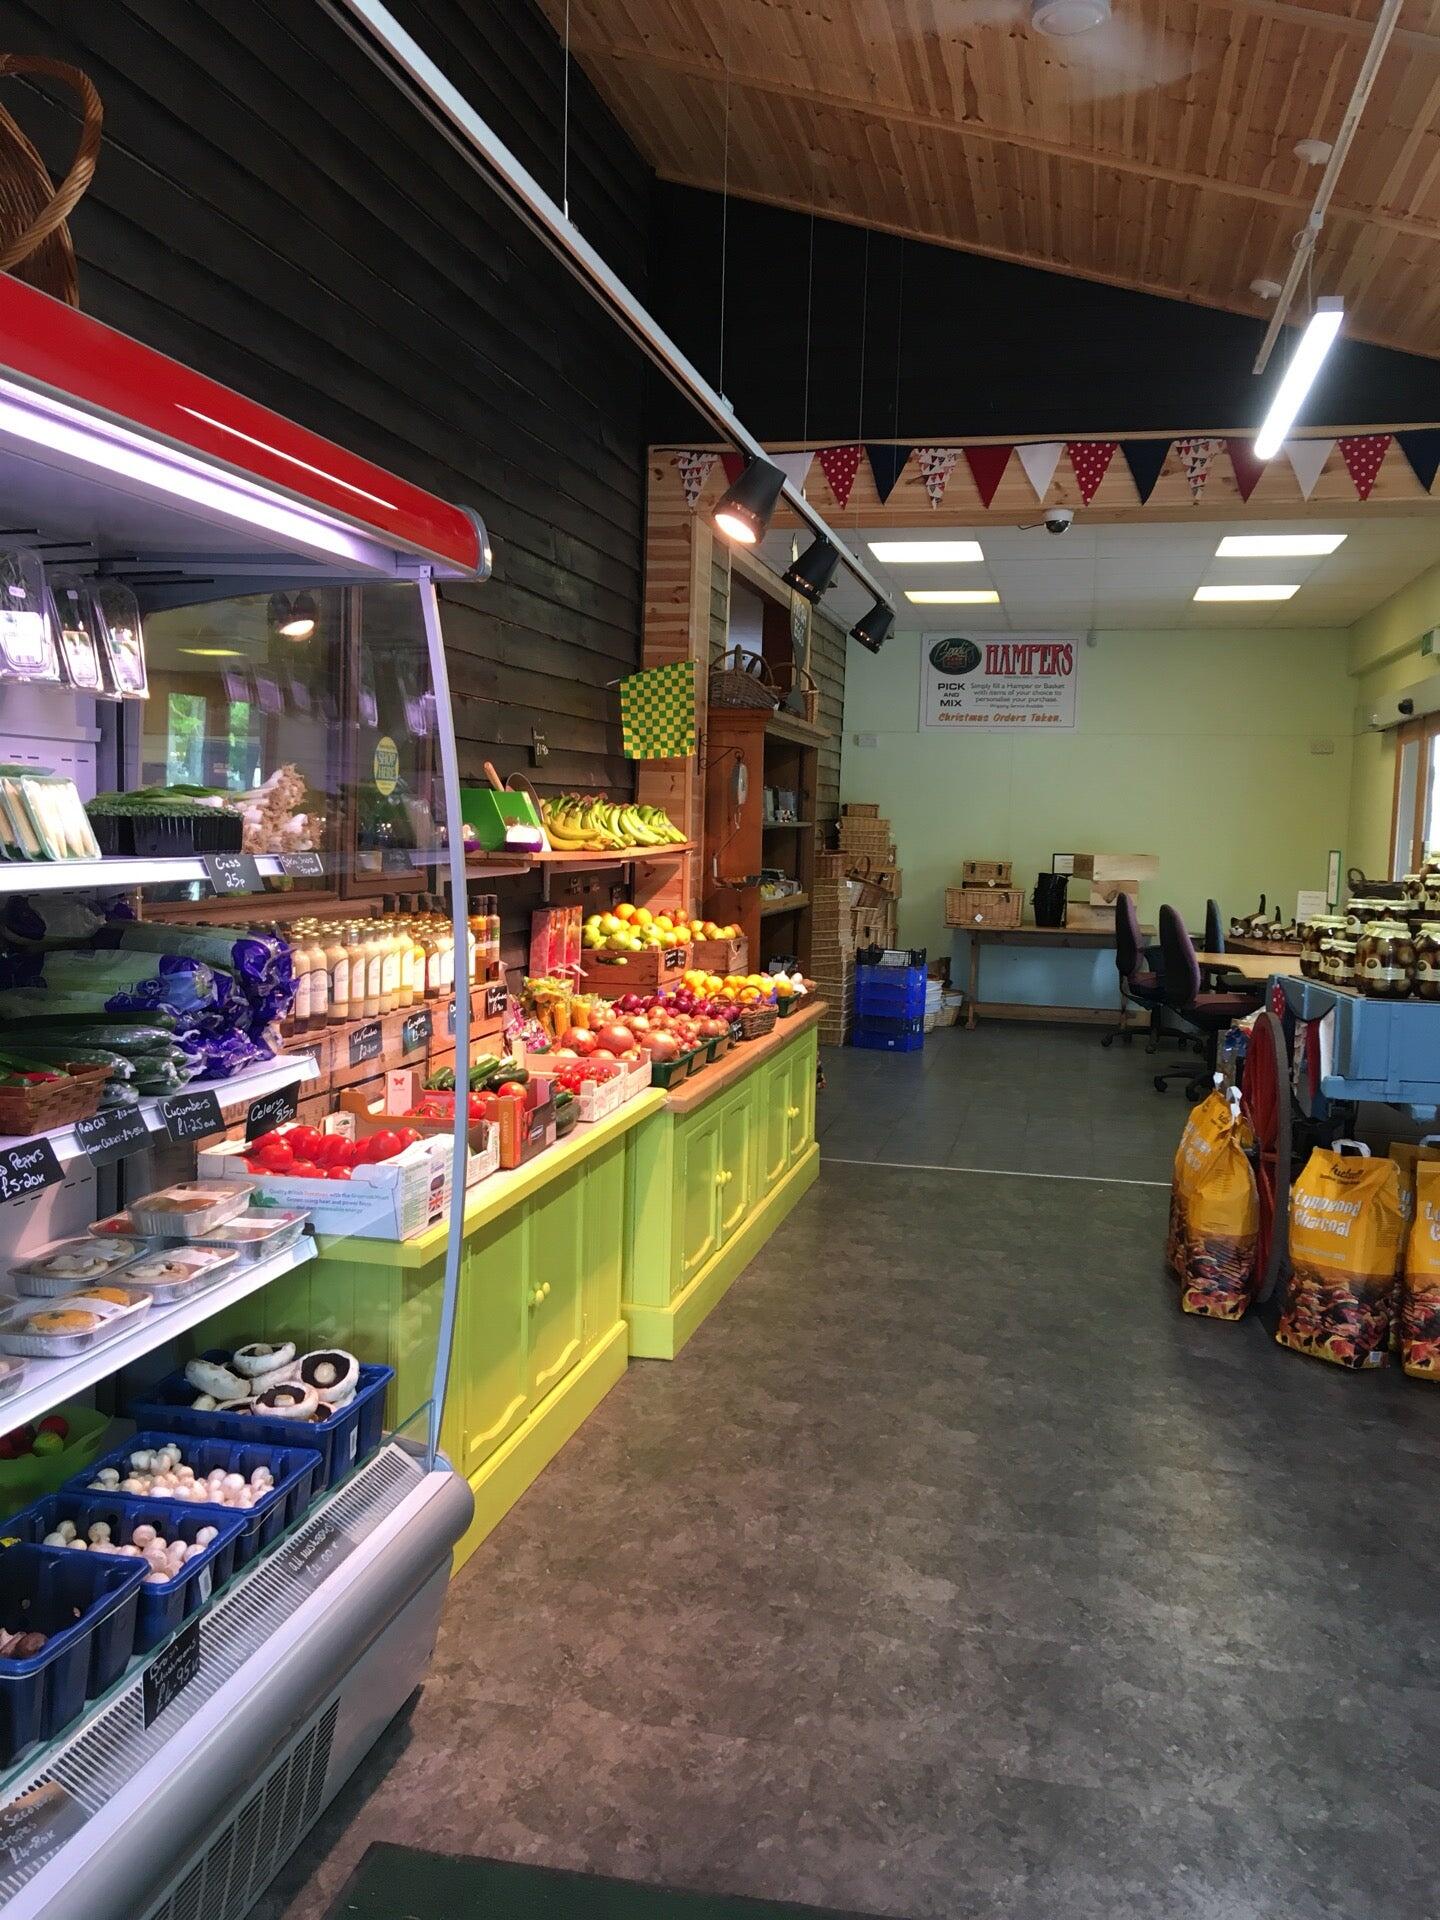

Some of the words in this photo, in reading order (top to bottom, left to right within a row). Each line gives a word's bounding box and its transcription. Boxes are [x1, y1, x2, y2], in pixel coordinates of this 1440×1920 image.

[985, 643, 1073, 677] HAMPERS
[938, 683, 965, 691] PICK
[970, 683, 990, 691] Simply
[1006, 683, 1032, 691] Hamper
[938, 712, 989, 722] Christmas
[993, 713, 1027, 722] Orders
[215, 857, 241, 870] Cress
[224, 872, 246, 888] 25p
[163, 1098, 211, 1119] Cucumbers
[250, 1098, 285, 1122] Celery
[275, 1105, 294, 1123] 85p
